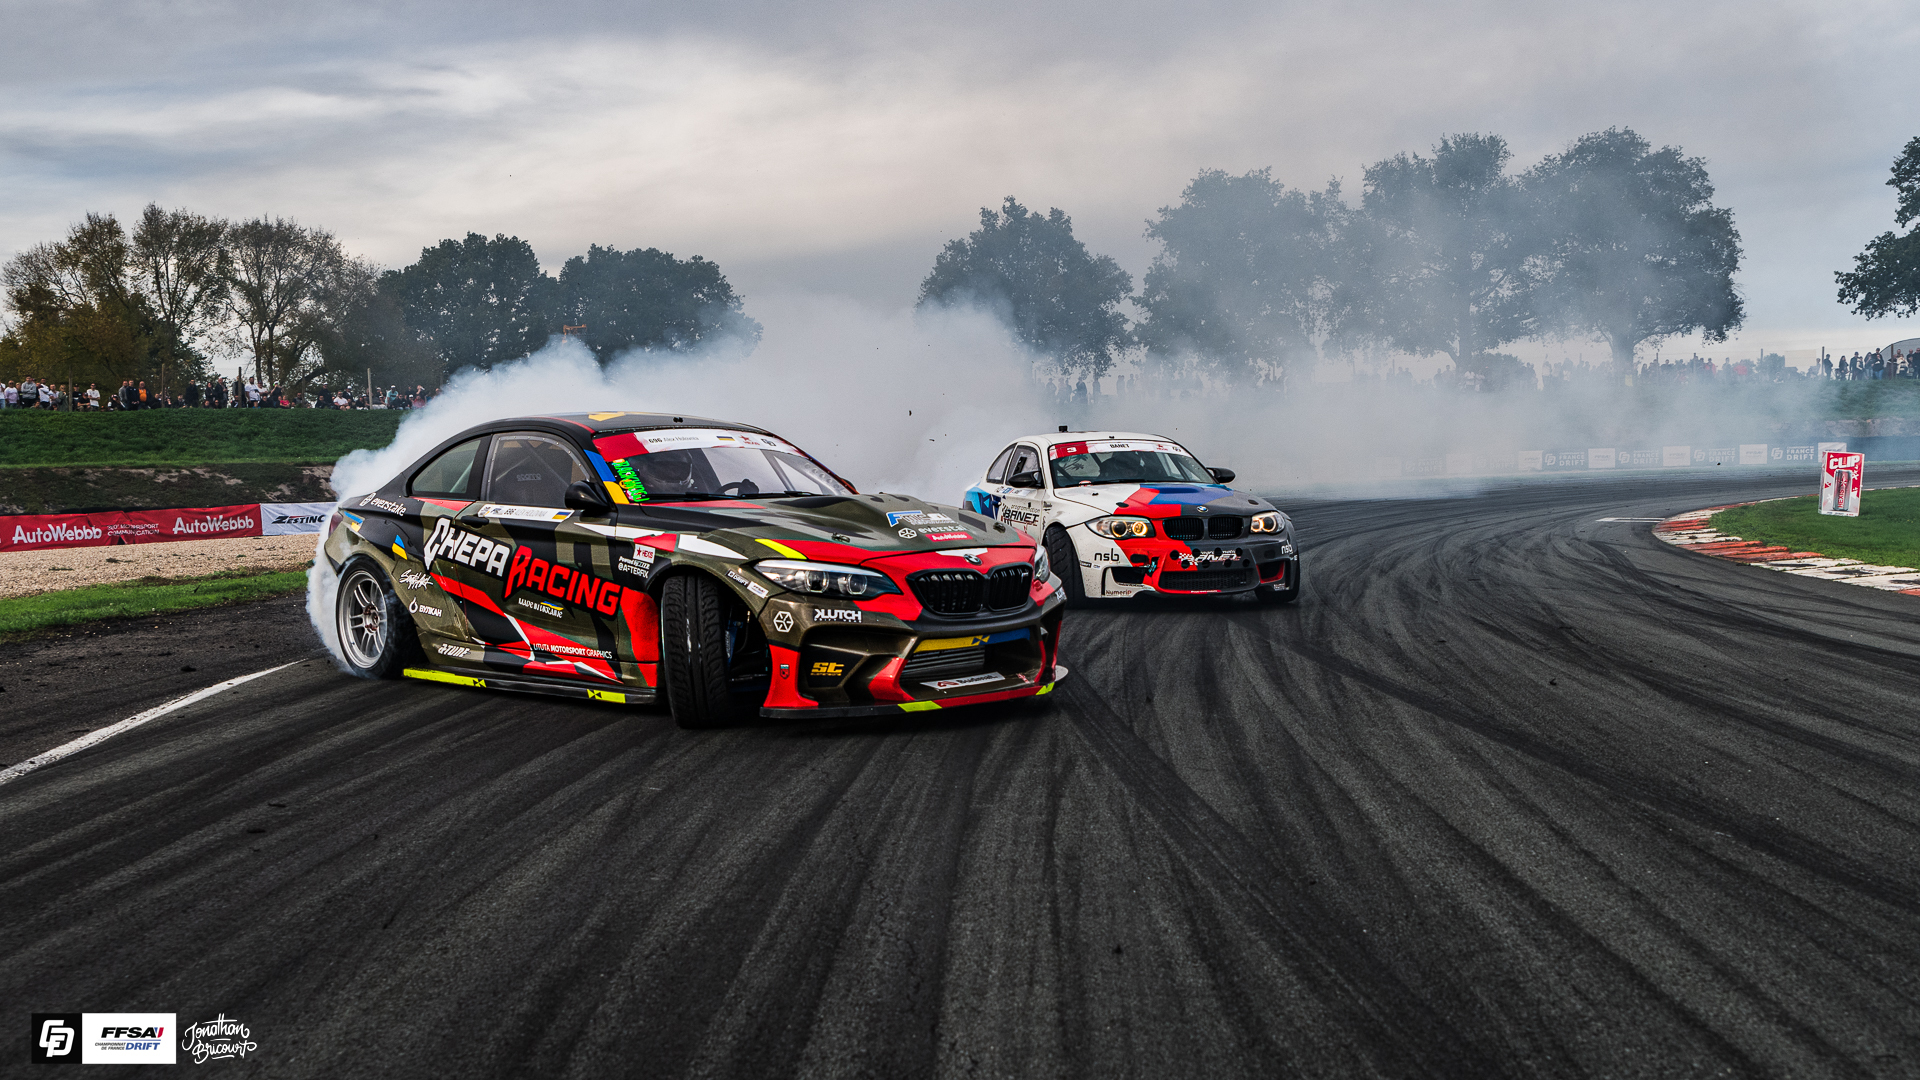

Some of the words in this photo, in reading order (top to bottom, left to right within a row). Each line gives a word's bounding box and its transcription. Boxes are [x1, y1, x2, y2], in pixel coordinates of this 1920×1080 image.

[1829, 455, 1860, 470] CLIP
[370, 497, 407, 517] everstake
[1837, 489, 1845, 509] HEXIS
[172, 514, 254, 535] AutoWebbb
[12, 523, 103, 544] AutoWebbb
[641, 550, 654, 558] HEXIS
[1094, 548, 1120, 562] nsb
[504, 545, 621, 616] RACING
[814, 608, 862, 620] KLUTCH
[550, 645, 586, 656] MOTORSPORT
[586, 649, 613, 659] GRAPHICS
